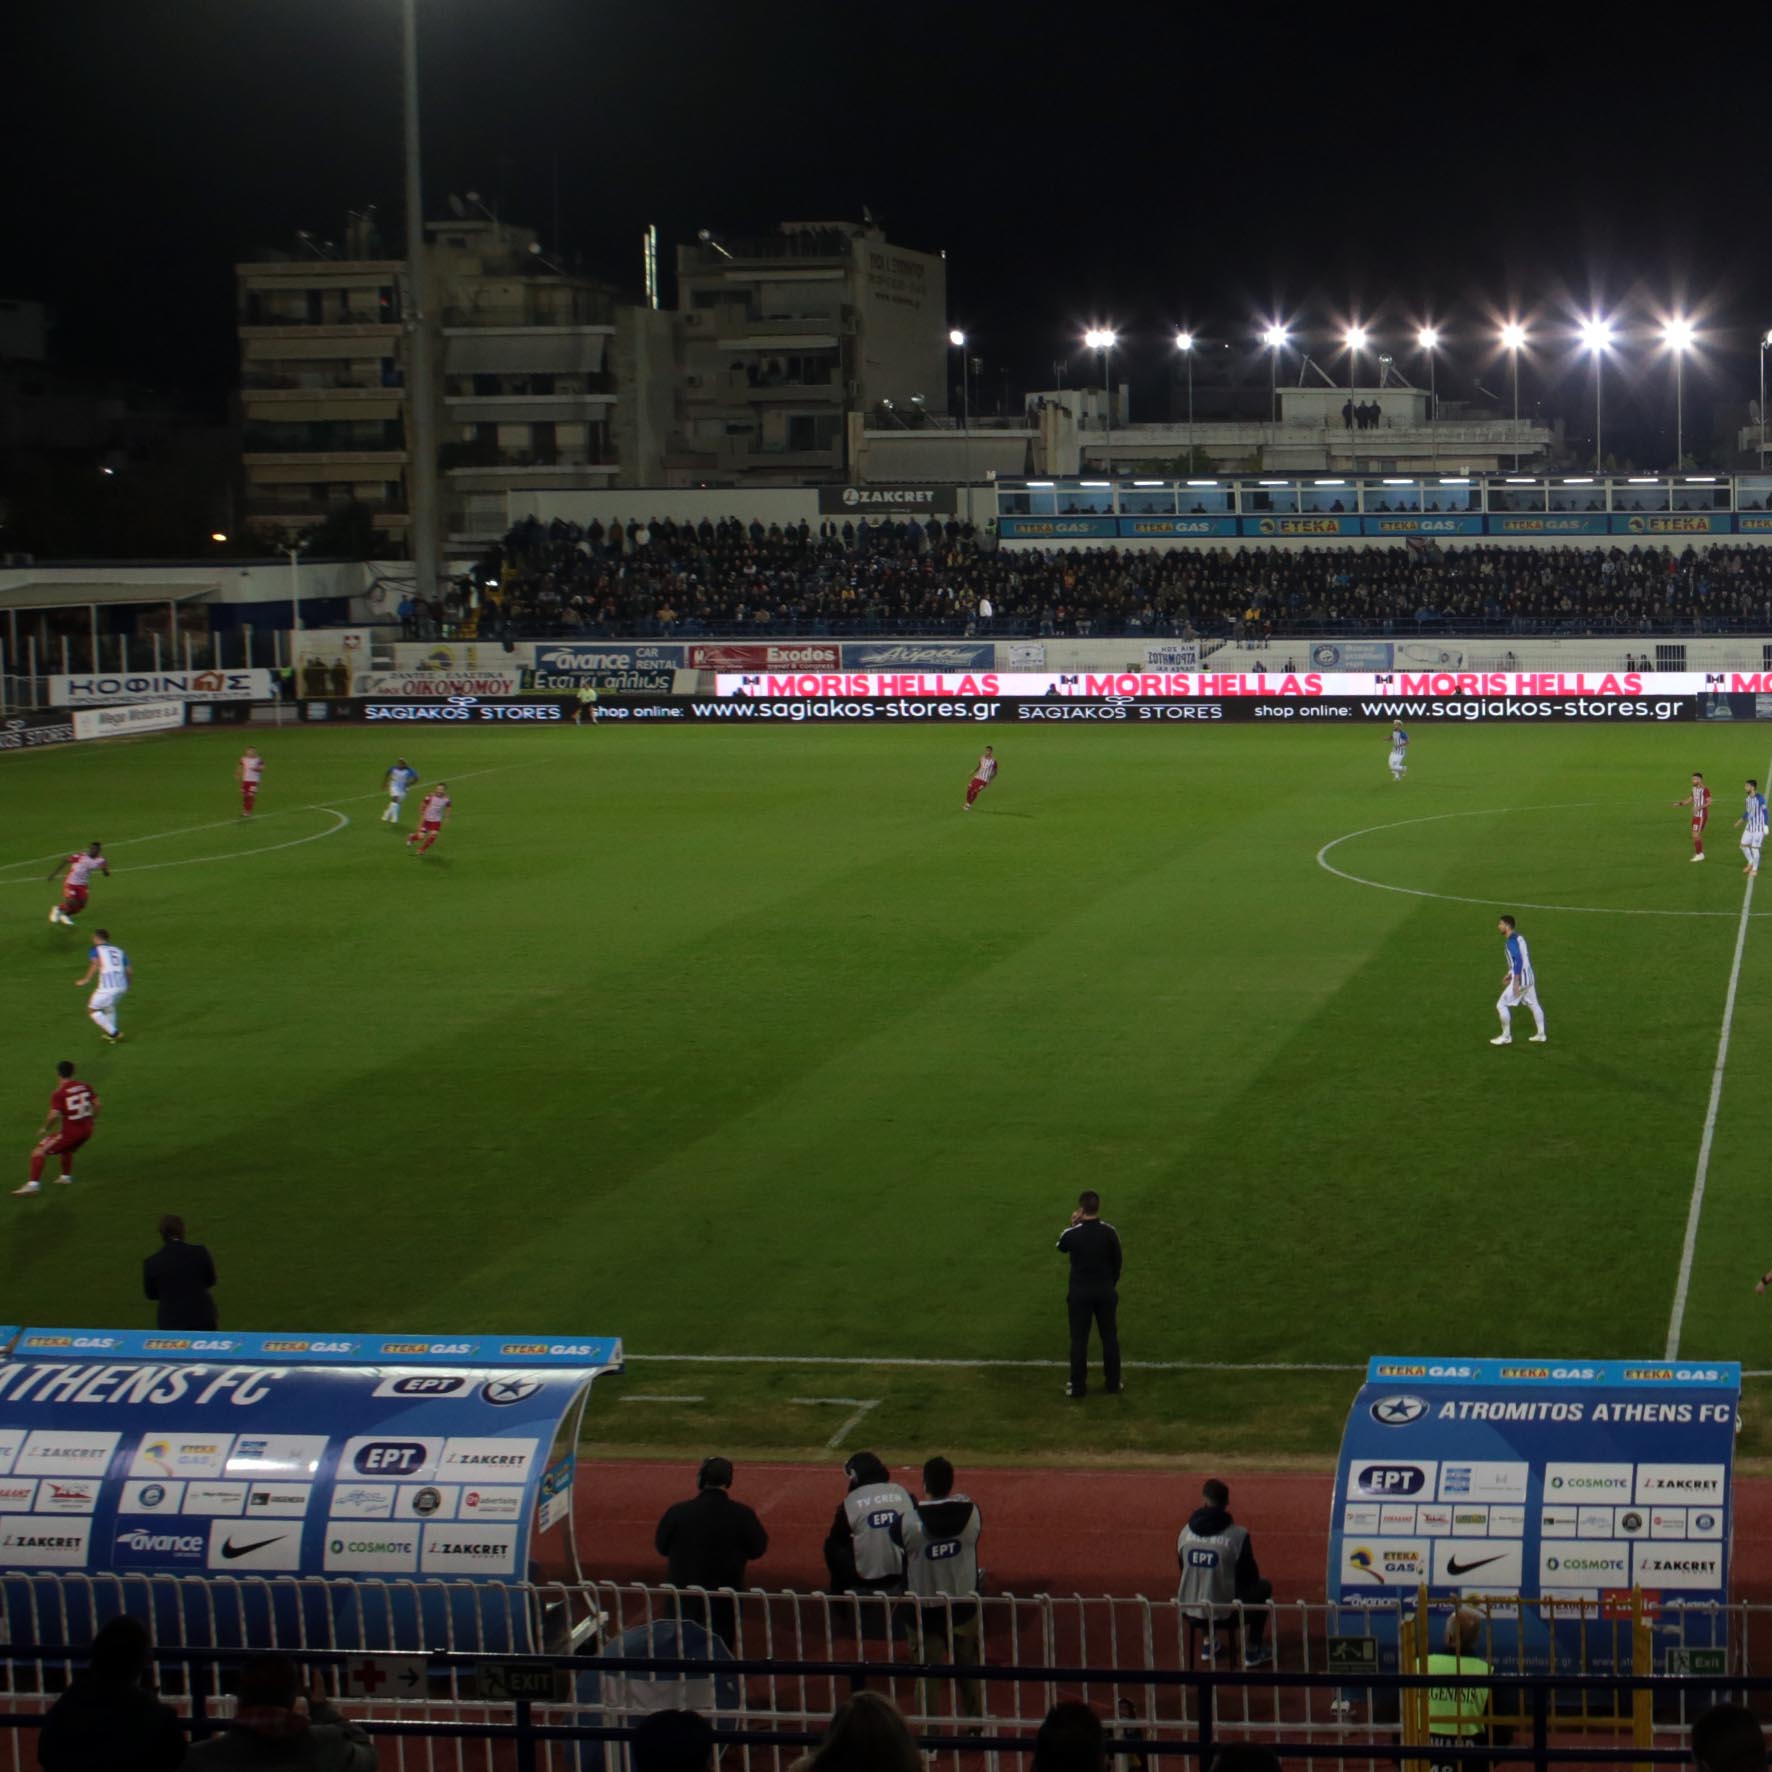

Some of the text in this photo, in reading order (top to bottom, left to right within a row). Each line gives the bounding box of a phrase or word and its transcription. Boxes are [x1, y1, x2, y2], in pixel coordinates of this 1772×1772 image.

[860, 490, 934, 503] ZAKCRET
[1056, 522, 1089, 532] GAS
[1176, 521, 1210, 532] GAS
[1279, 519, 1340, 534] ETEKA
[1380, 520, 1456, 531] ETEKA GAS
[1503, 519, 1580, 530] ETEKA GAS
[1648, 518, 1709, 532] ETEKA
[636, 648, 660, 658] CAR
[767, 648, 834, 662] Exodos
[556, 654, 632, 670] avance
[636, 660, 679, 670] RENTAL
[402, 680, 513, 695] ΟΙΚΟΝΟΜΟΥ
[768, 675, 1000, 697] MORIS HELLAS
[1085, 674, 1324, 696] MORIS HELLAS
[1400, 673, 1644, 696] MORIS HELLAS
[365, 706, 560, 719] SAGIAKOS STORES
[634, 704, 685, 717] online:
[691, 699, 1001, 720] www.sagiakos-stores.gr
[1018, 707, 1223, 719] SAGIAKOS STORES
[1254, 698, 1685, 720] shop online: www.sagiakos-stores.gr
[26, 1337, 115, 1349] ETEKA GAS
[143, 1338, 233, 1351] ETEKA GAS
[263, 1341, 352, 1353] ETEKA GAS
[383, 1343, 472, 1354] ETEKA GAS
[502, 1344, 592, 1356] ETEKA GAS
[1378, 1364, 1470, 1378] ETEKA GAS
[1500, 1367, 1594, 1379] ETEKA GAS
[1624, 1369, 1718, 1381] ETEKA GAS
[195, 1365, 288, 1406] FC
[1438, 1401, 1731, 1423] ATROMITOS ATHENS FC
[365, 1449, 417, 1469] ΕΡΤ
[461, 1455, 527, 1465] ZAKCRET
[1371, 1470, 1414, 1490] ΕΡΤ
[1567, 1477, 1628, 1488] COSMOTE
[1657, 1479, 1718, 1490] ZAKCRET
[873, 1512, 894, 1525] ΕΡΤ
[16, 1536, 83, 1548] ZAKCRET
[131, 1534, 204, 1553] avance
[348, 1542, 412, 1553] COSMOTE
[442, 1544, 509, 1555] ZAKCRET
[931, 1543, 956, 1557] ΕΡΤ
[1192, 1552, 1214, 1565] ΕΡΤ
[1383, 1552, 1419, 1561] ETEKA
[1384, 1562, 1415, 1572] GAS
[1563, 1559, 1624, 1570] COSMOTE
[1653, 1560, 1715, 1571] ZAKCRET
[512, 1672, 552, 1691] EXIT
[1430, 1686, 1477, 1704] GENSIS
